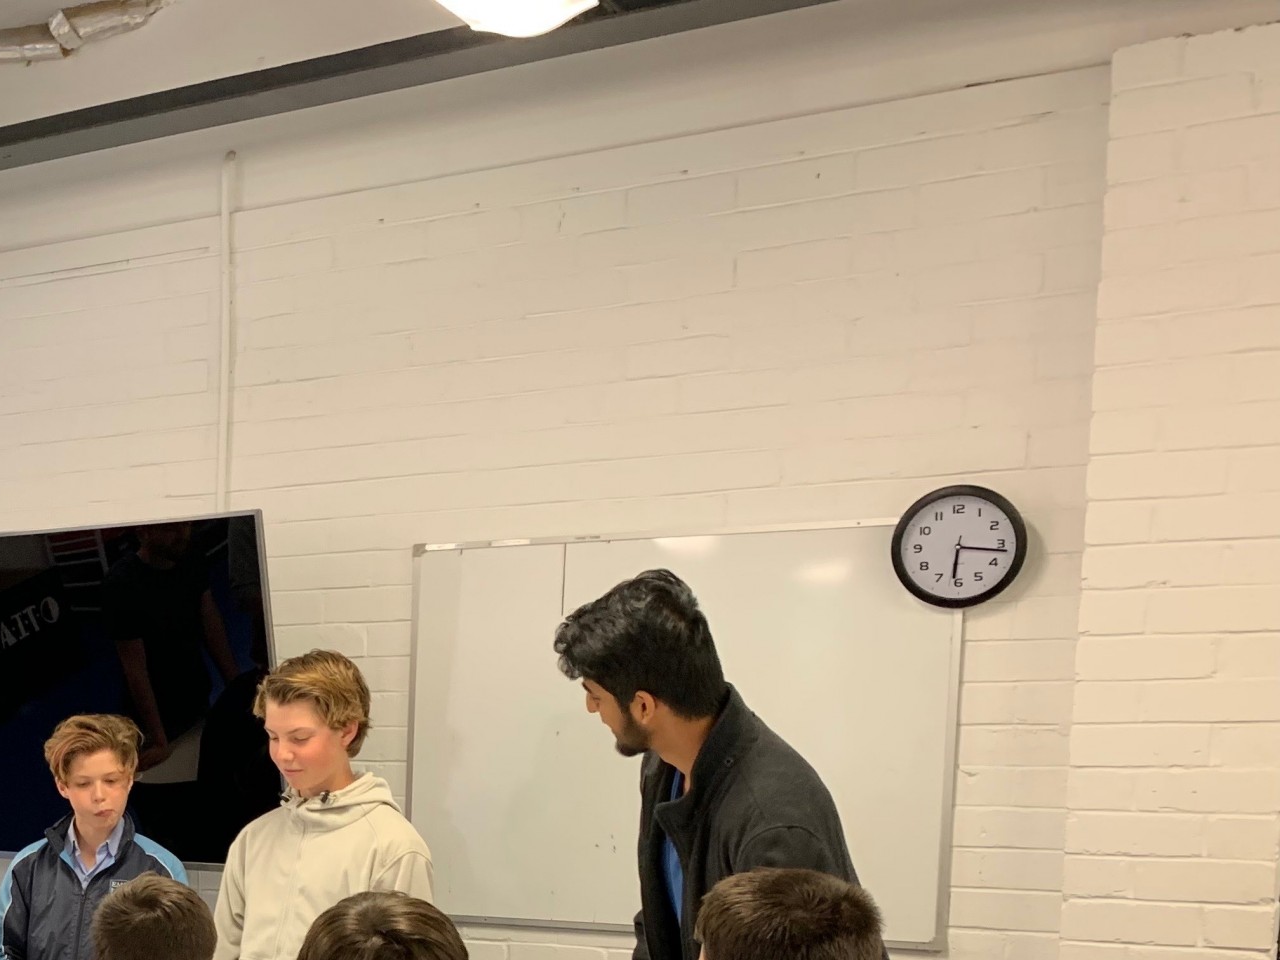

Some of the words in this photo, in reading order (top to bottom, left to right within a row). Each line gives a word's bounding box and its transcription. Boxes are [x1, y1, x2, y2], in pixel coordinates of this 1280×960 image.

[952, 504, 966, 514] 12
[977, 508, 982, 517] 1
[934, 511, 944, 521] 11
[989, 521, 1000, 530] 2
[919, 526, 932, 536] 10
[996, 538, 1006, 549] 3
[913, 544, 923, 554] 9
[919, 561, 929, 571] 8
[988, 557, 999, 567] 4
[934, 573, 944, 583] 7
[973, 571, 984, 582] 5
[953, 577, 964, 588] 6
